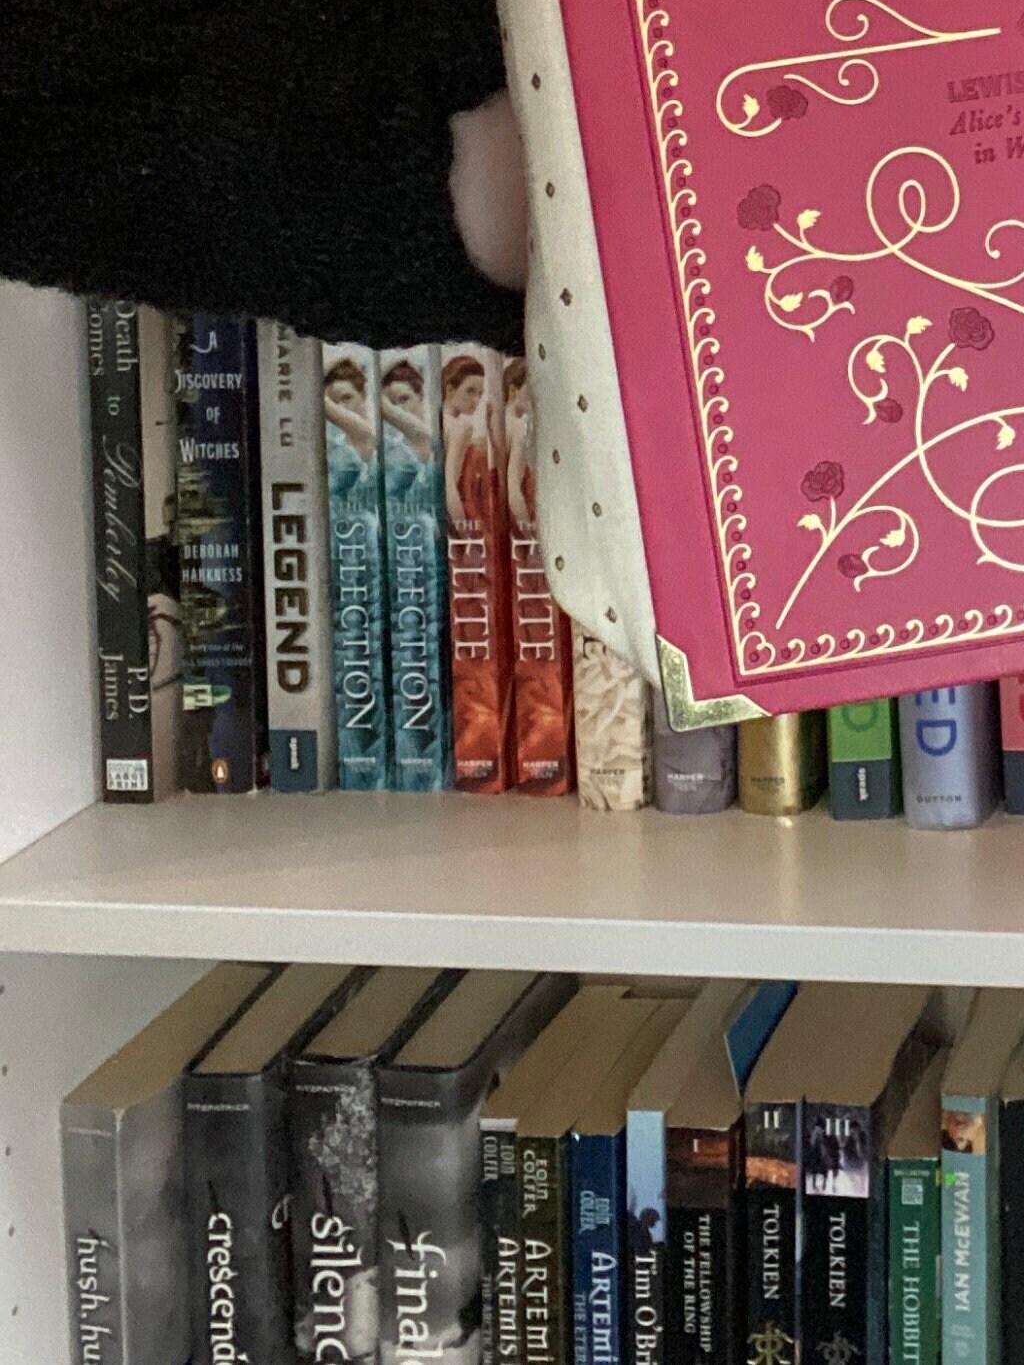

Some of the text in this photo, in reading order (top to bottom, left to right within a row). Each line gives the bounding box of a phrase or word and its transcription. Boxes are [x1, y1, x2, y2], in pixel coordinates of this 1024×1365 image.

[949, 105, 1021, 136] Alice's
[974, 142, 996, 164] in
[115, 300, 138, 371] Death
[174, 369, 242, 393] DISCOVERY
[179, 436, 240, 463] WITCHES
[98, 396, 141, 602] to Pemberley
[182, 566, 243, 583] HARKNESS
[183, 543, 239, 560] DEBORAH
[271, 482, 310, 694] LEGEND
[448, 519, 490, 663] THE ELITE
[511, 536, 555, 663] ELITE
[334, 520, 376, 730] SELECTION
[392, 520, 433, 731] SELECTION
[101, 653, 123, 721] James
[127, 667, 149, 719] P. D.
[289, 736, 299, 772] speak
[522, 761, 559, 770] HARPER
[590, 769, 625, 777] HARPER
[667, 774, 704, 782] HARPER
[916, 795, 962, 804] DUTTON
[762, 1111, 781, 1129] II
[824, 1118, 851, 1137] III
[482, 1136, 498, 1182] COLFER
[522, 1149, 538, 1217] COLFER
[579, 1189, 596, 1234] COLFER
[634, 1249, 658, 1299] Tim
[762, 1203, 781, 1301] TOLKIEN
[828, 1212, 847, 1309] TOLKIEN
[683, 1232, 696, 1333] OF THE RING
[699, 1214, 712, 1353] THE FELLOWSHIP
[903, 1221, 920, 1365] THE HOBBIT
[955, 1272, 971, 1312] IAN
[574, 1292, 587, 1321] THE
